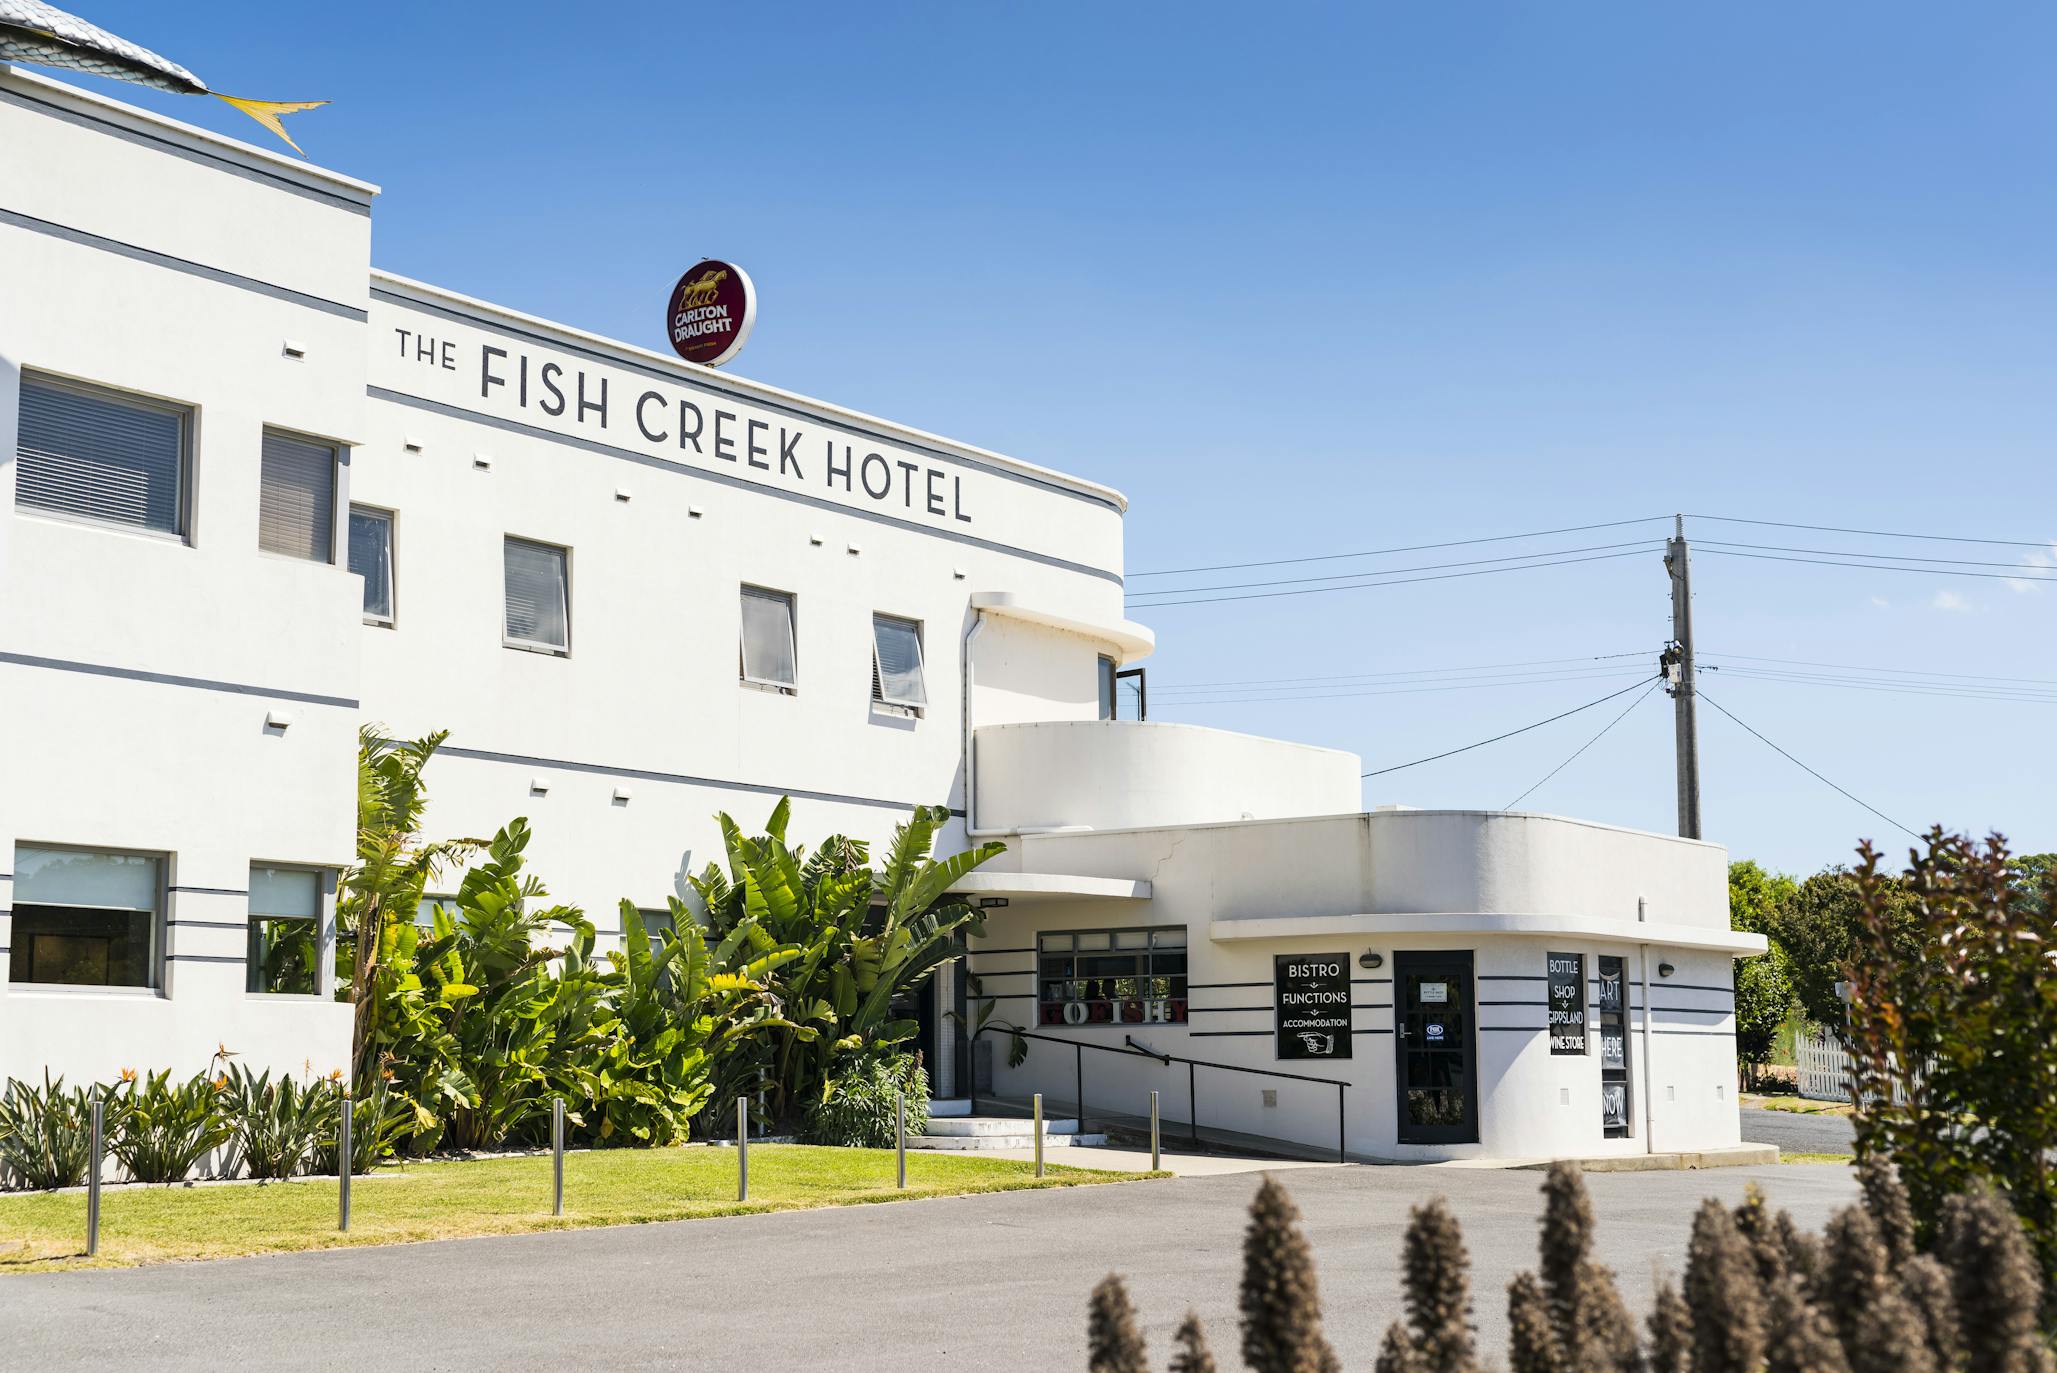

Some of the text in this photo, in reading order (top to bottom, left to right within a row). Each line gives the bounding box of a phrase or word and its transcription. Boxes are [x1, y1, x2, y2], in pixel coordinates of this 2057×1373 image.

[675, 305, 728, 327] CARLTON
[674, 318, 732, 343] DRAUGHT
[395, 328, 972, 523] THE FISH CREEK HOTEL
[1289, 964, 1340, 977] BISTRO
[1550, 960, 1578, 973] BOTTLE
[1554, 985, 1576, 999] SHOP
[1599, 981, 1620, 1000] ART
[1282, 992, 1347, 1005] FUNCTIONS
[1283, 1019, 1347, 1028] ACCOMMODATION
[1548, 1010, 1583, 1024] GIPPSLAND
[1566, 1036, 1584, 1049] STORE
[1602, 1036, 1623, 1057] HERE
[1603, 1090, 1624, 1115] NOW
